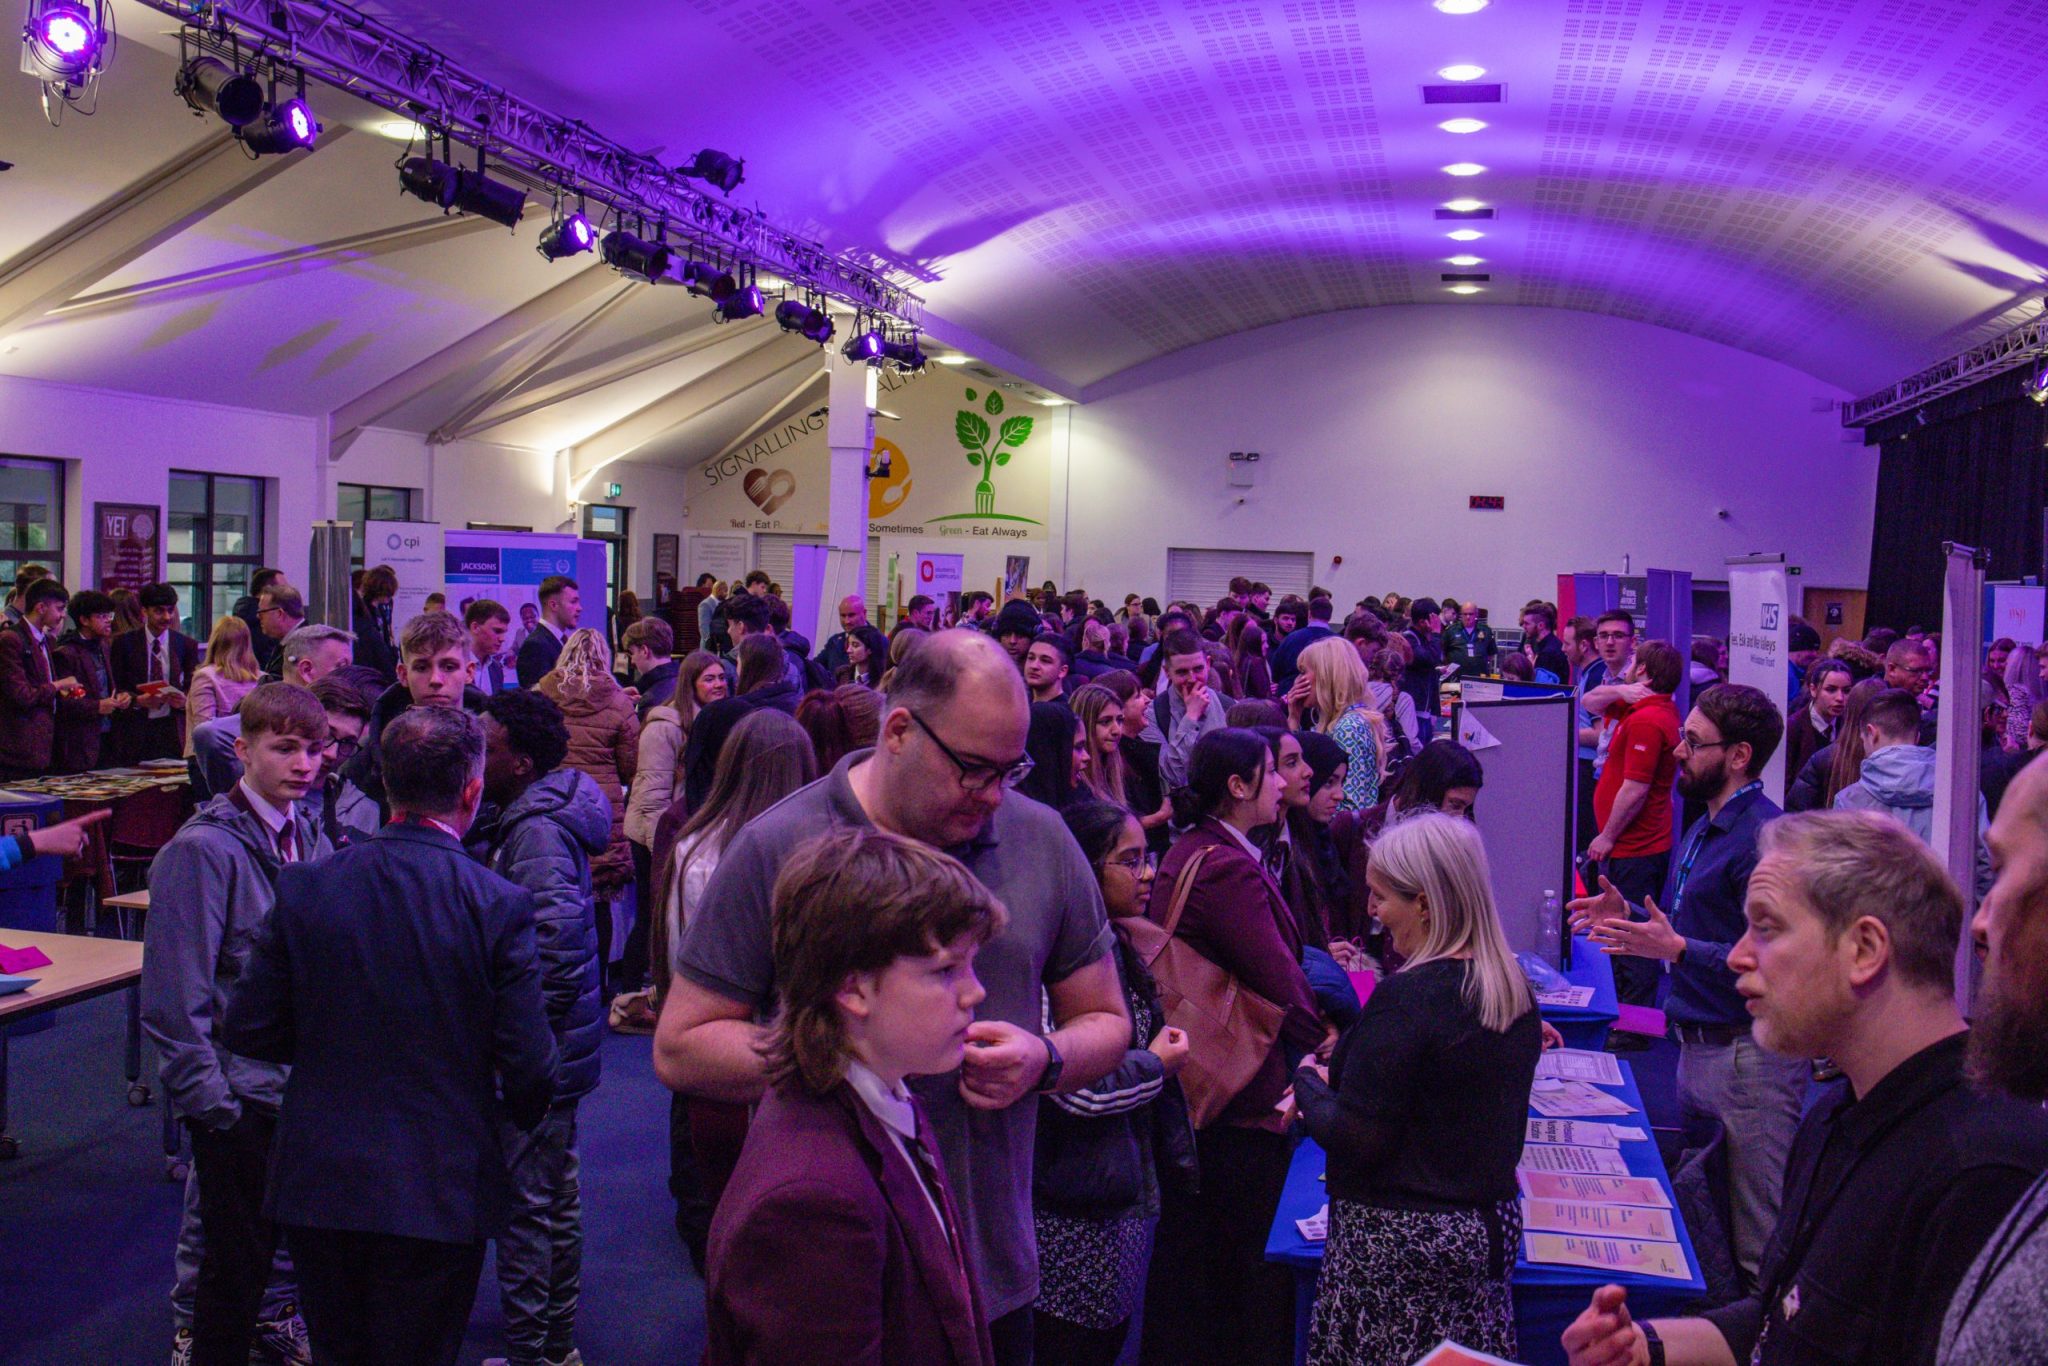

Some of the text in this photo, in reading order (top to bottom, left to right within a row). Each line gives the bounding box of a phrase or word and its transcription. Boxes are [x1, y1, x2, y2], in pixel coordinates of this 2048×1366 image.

[704, 414, 825, 487] SIGNALLING
[107, 515, 127, 537] YET
[754, 519, 771, 529] Eat
[868, 522, 924, 535] Sometimes
[938, 525, 963, 537] Green
[972, 526, 989, 536] Eat
[991, 527, 1028, 538] Always
[403, 536, 420, 549] cpi
[461, 562, 497, 571] JACKSONS
[1761, 604, 1778, 629] NHS
